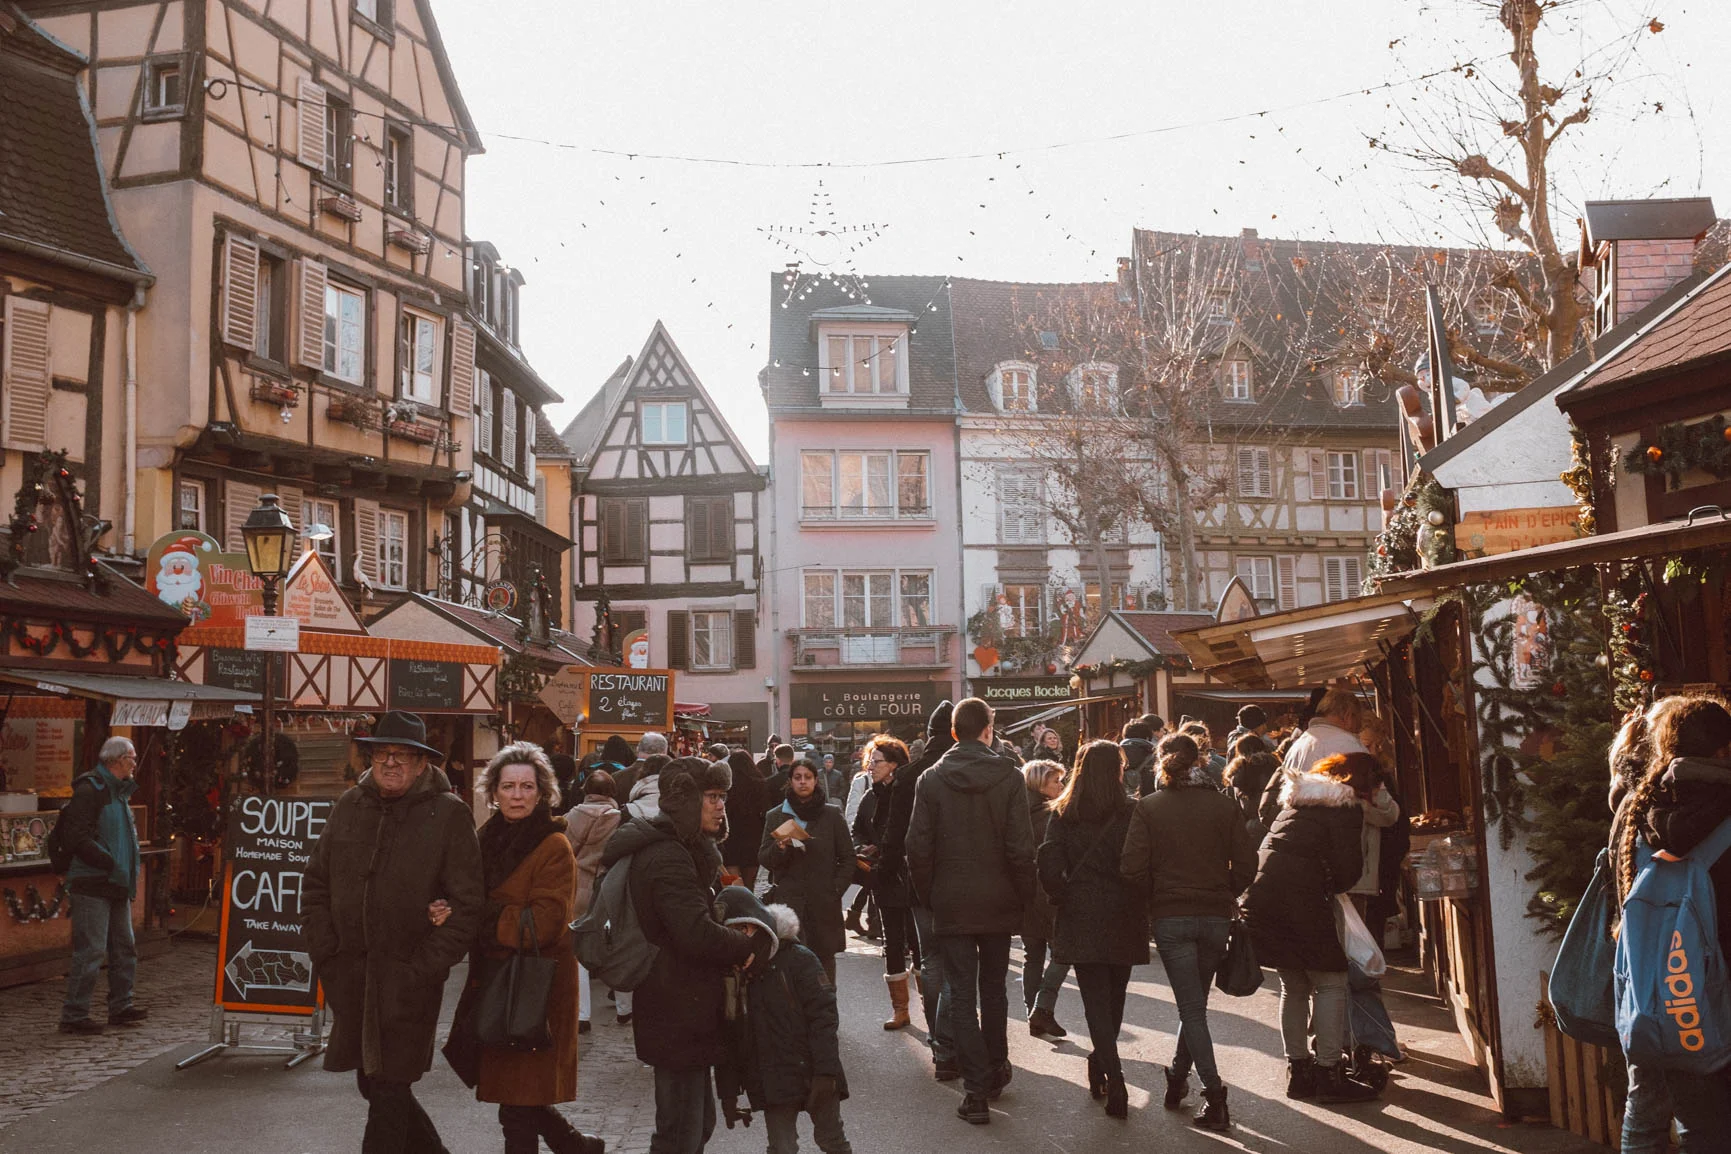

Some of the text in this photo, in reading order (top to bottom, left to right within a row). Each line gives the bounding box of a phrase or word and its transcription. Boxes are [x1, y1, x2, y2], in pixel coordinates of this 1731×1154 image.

[208, 563, 266, 591] Vin Cha
[590, 674, 668, 692] RESTAURANT
[843, 691, 921, 702] Boulangerie
[984, 684, 1070, 700] Jacques Bockel
[598, 696, 613, 712] 2
[823, 703, 922, 716] côté FOUR
[241, 796, 331, 840] SOUPE
[243, 918, 303, 935] TAKE AWAY
[1664, 930, 1705, 1052] adidas
